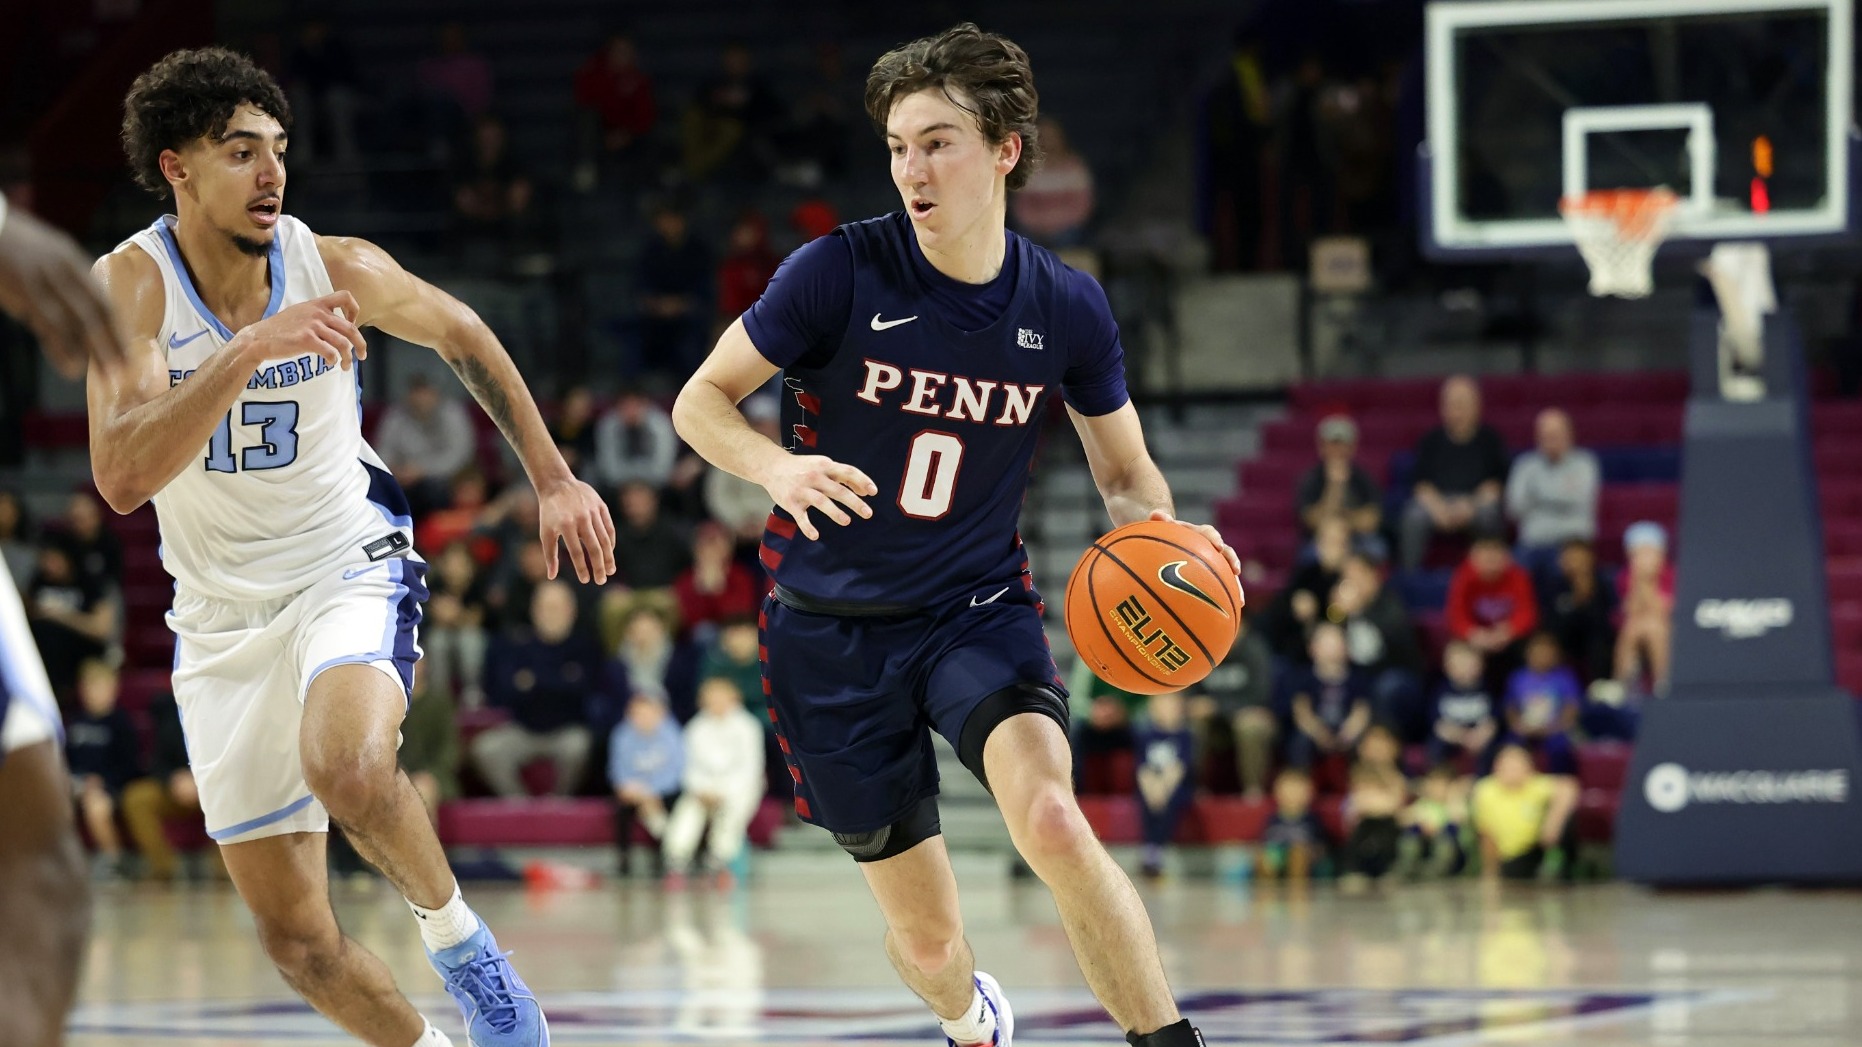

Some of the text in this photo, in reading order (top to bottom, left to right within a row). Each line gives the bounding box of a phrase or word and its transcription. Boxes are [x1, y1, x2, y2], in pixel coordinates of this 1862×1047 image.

[168, 354, 335, 390] CMBIA
[1024, 333, 1044, 345] IVY
[856, 357, 1045, 426] PENN
[205, 400, 300, 474] 13
[896, 428, 966, 522] 0
[393, 537, 402, 545] L
[1108, 609, 1172, 677] CHAMPIONSHIP
[1115, 594, 1193, 673] ELITE
